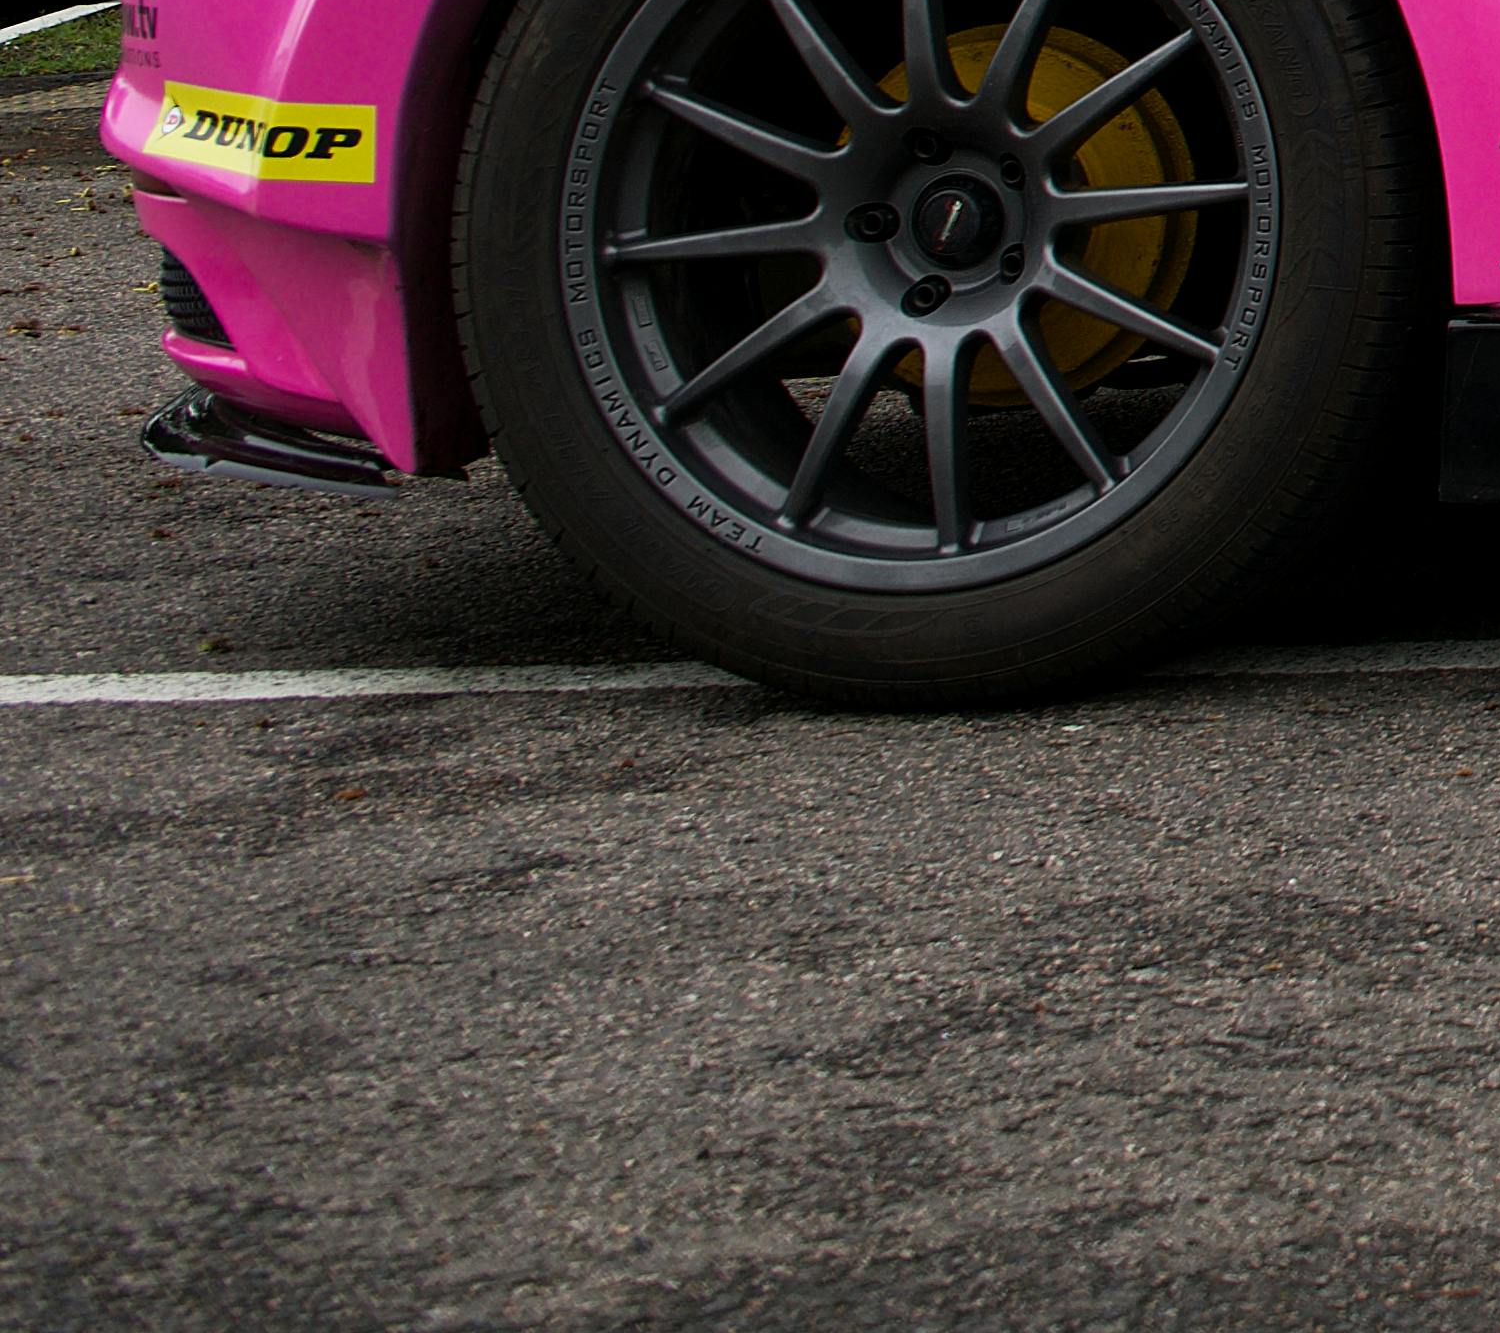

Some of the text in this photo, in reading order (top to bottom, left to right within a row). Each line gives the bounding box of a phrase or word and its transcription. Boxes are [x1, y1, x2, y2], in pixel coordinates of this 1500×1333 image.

[183, 110, 362, 160] DUNOP
[570, 76, 618, 304] MOTORSPORT
[1222, 144, 1273, 372] MOTORSPORT
[579, 328, 678, 486] DYNAMICS
[686, 494, 764, 554] TEAM
